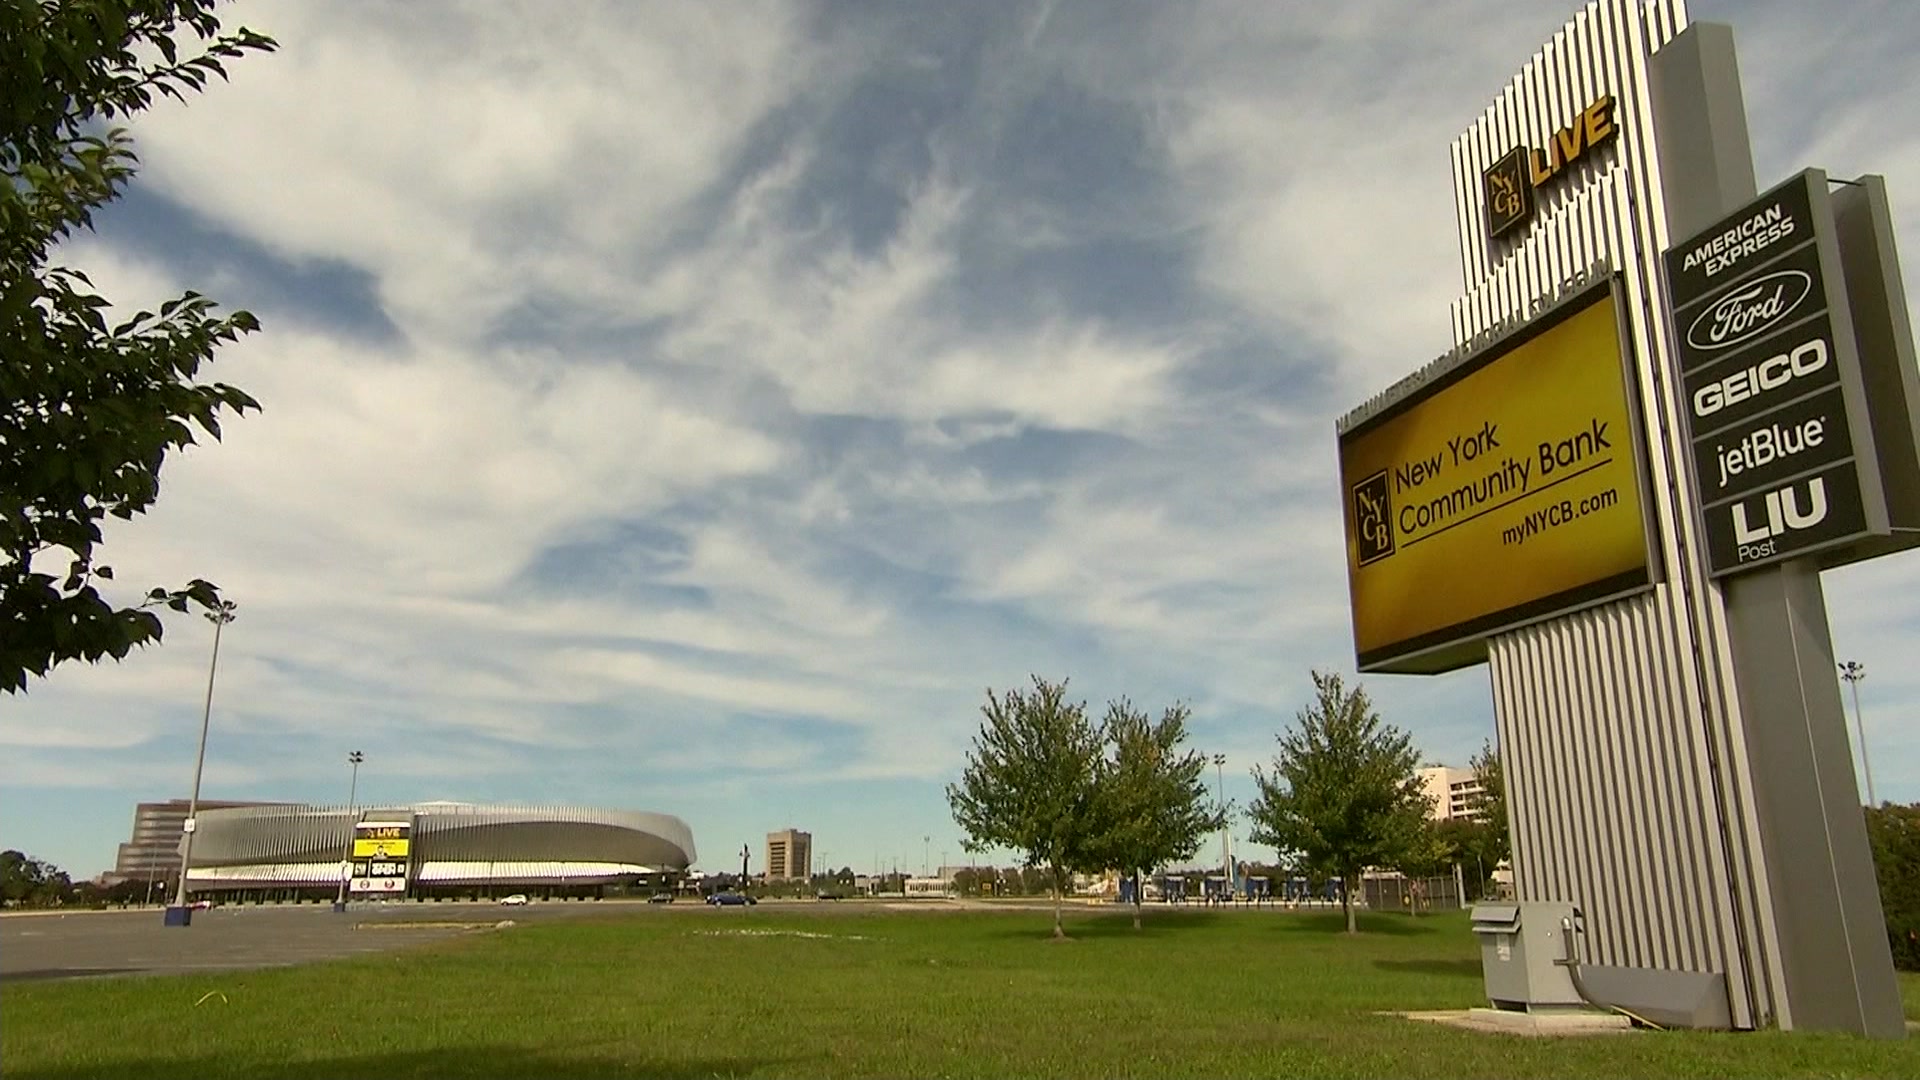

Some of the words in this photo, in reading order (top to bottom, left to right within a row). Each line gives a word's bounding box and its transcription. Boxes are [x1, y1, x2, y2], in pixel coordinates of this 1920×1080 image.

[1531, 95, 1618, 187] LIVE
[1683, 203, 1782, 272] AMERICAN
[1705, 215, 1795, 277] EXPRESS
[1710, 284, 1785, 342] Ford
[1693, 338, 1828, 417] GEICO
[1396, 451, 1443, 494] New
[1448, 421, 1501, 466] York
[1400, 456, 1531, 534] Community
[1538, 418, 1612, 475] Bank
[1717, 417, 1825, 488] jetBlue
[1502, 487, 1619, 545] myNYCB.com
[1731, 477, 1828, 545] LIU
[1737, 539, 1777, 562] Post
[377, 827, 401, 838] LIVE
